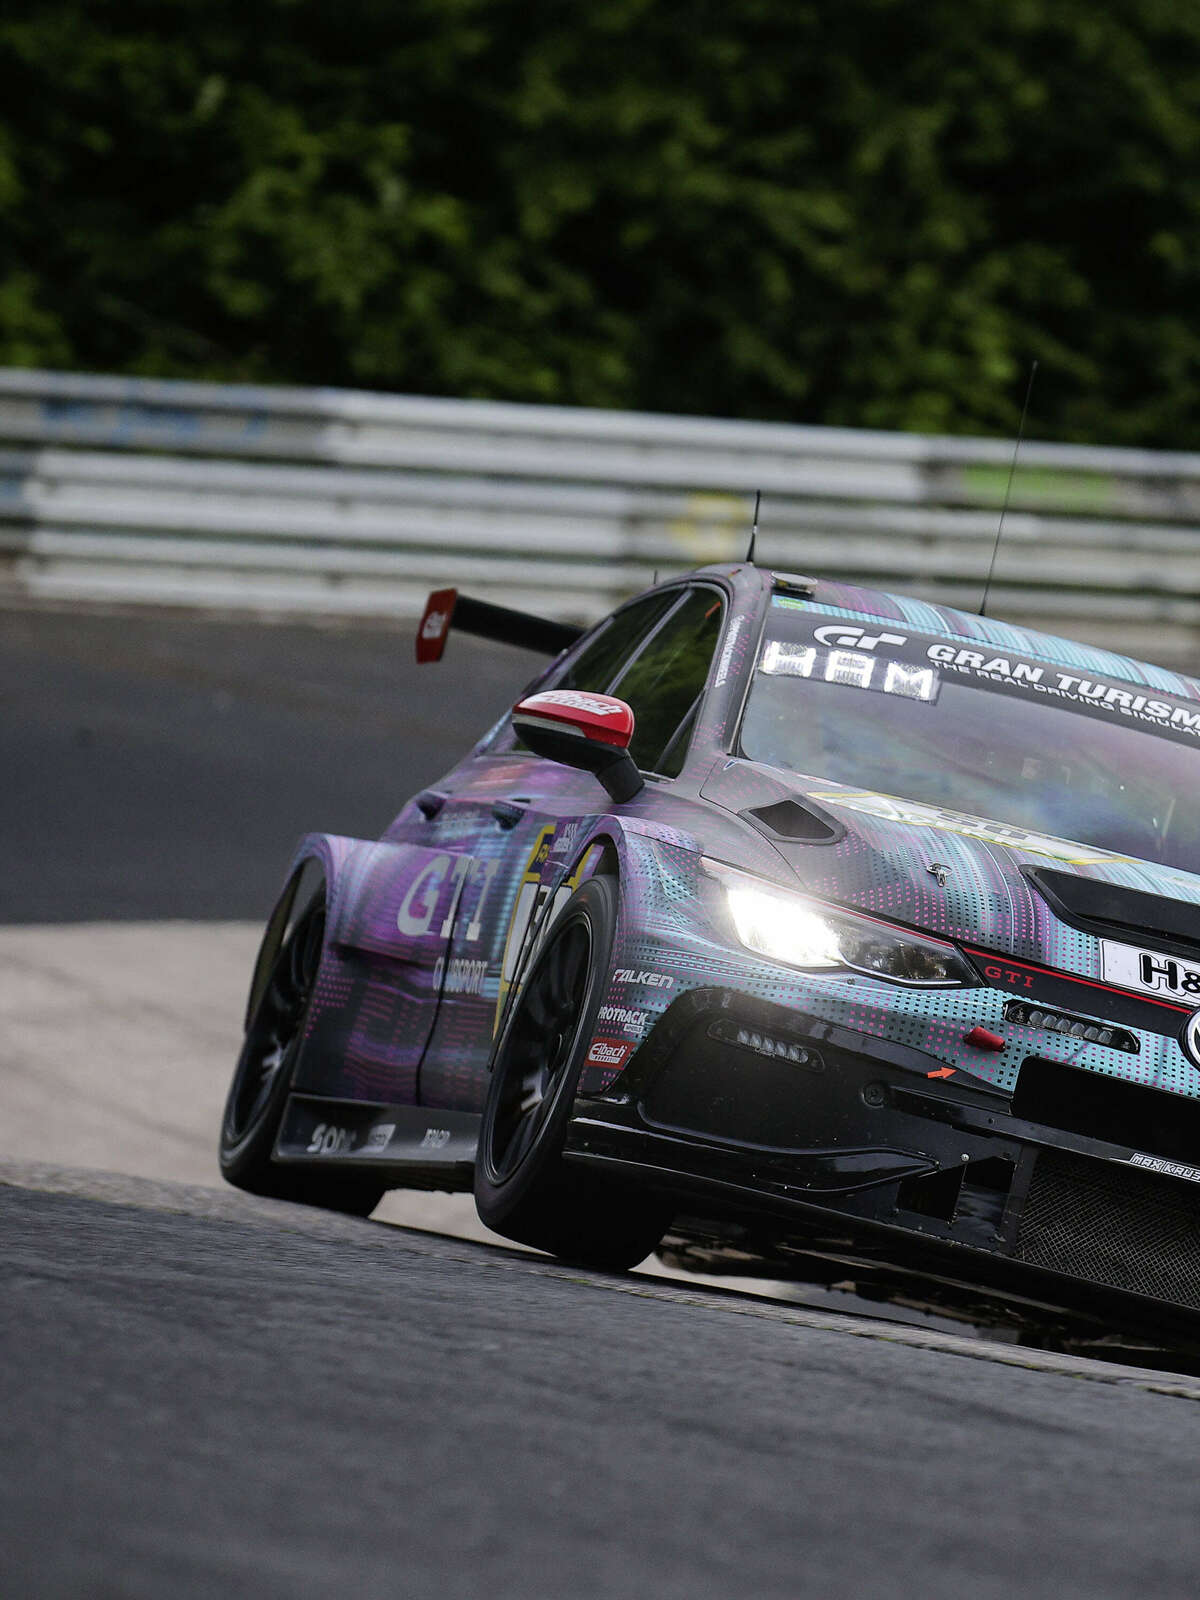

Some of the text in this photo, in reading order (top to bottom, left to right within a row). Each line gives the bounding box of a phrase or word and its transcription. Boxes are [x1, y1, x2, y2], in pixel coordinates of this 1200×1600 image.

[813, 625, 908, 650] GT
[763, 641, 935, 701] HAM
[927, 644, 1045, 683] GRAN
[929, 659, 970, 674] THE
[977, 669, 1029, 688] REAL
[1033, 683, 1115, 711] DRIVING
[397, 854, 501, 941] GTI
[612, 968, 674, 989] FALKEN
[984, 966, 1036, 988] GTI
[588, 1042, 628, 1062] Eibach
[1132, 1154, 1163, 1171] MAX
